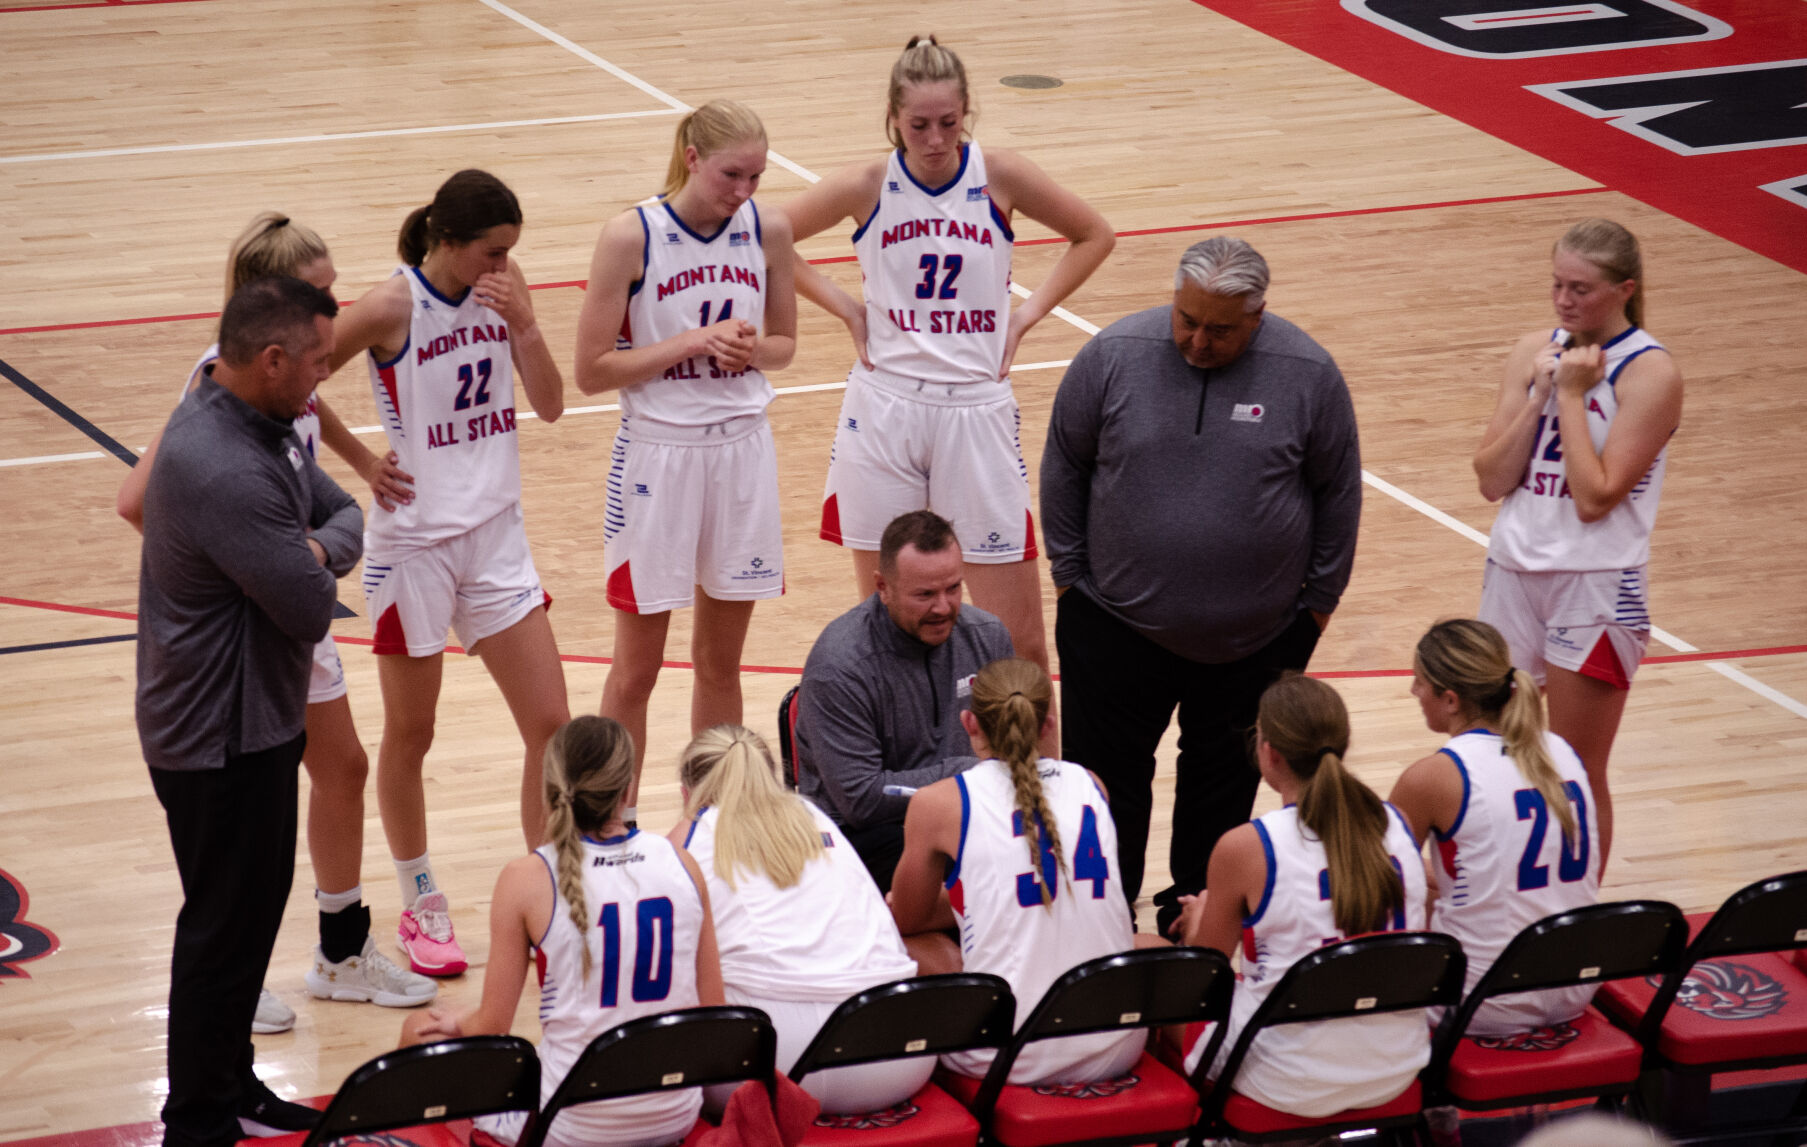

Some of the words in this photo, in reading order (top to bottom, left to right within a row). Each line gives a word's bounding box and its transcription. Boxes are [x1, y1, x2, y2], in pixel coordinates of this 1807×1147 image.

[882, 219, 993, 249] MONTANA
[657, 265, 760, 302] MONTANA
[915, 254, 963, 300] 32
[930, 309, 996, 334] STARS
[454, 357, 493, 412] 22
[428, 422, 459, 450] ALL
[468, 408, 517, 442] STAR
[1012, 804, 1110, 909] 34
[1514, 780, 1590, 892] 20
[597, 896, 674, 1008] 10
